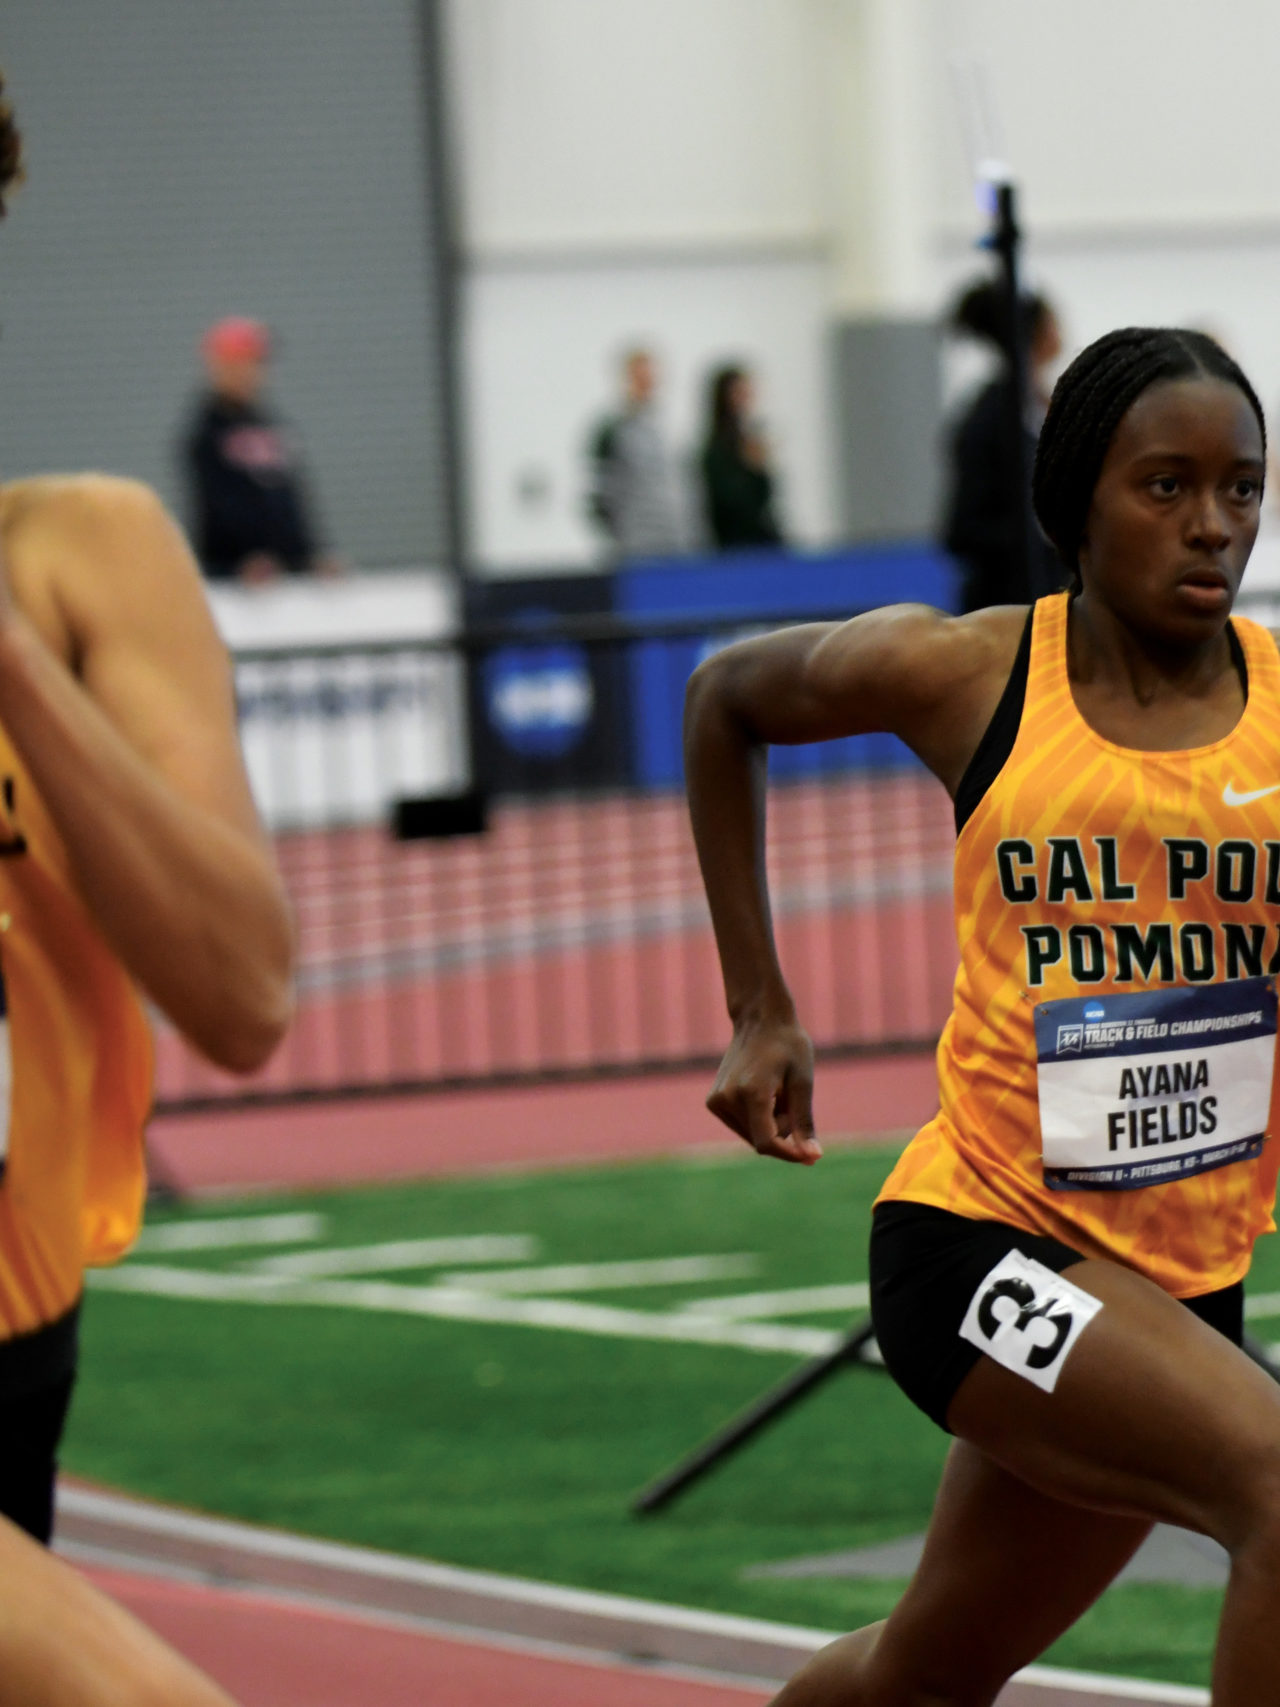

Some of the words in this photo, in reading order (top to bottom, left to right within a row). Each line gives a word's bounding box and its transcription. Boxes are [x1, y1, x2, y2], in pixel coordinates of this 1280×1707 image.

[995, 836, 1137, 904] CAL
[1084, 1026, 1124, 1044] TRACK
[1125, 1026, 1134, 1040] &
[1136, 1023, 1168, 1039] FIELD
[1170, 1011, 1263, 1036] CHAMPIONSHIPS
[1118, 1059, 1209, 1100] AYANA
[1108, 1096, 1218, 1151] FIELDS
[1067, 1170, 1114, 1182] DIVISION
[977, 1277, 1073, 1369] 3
